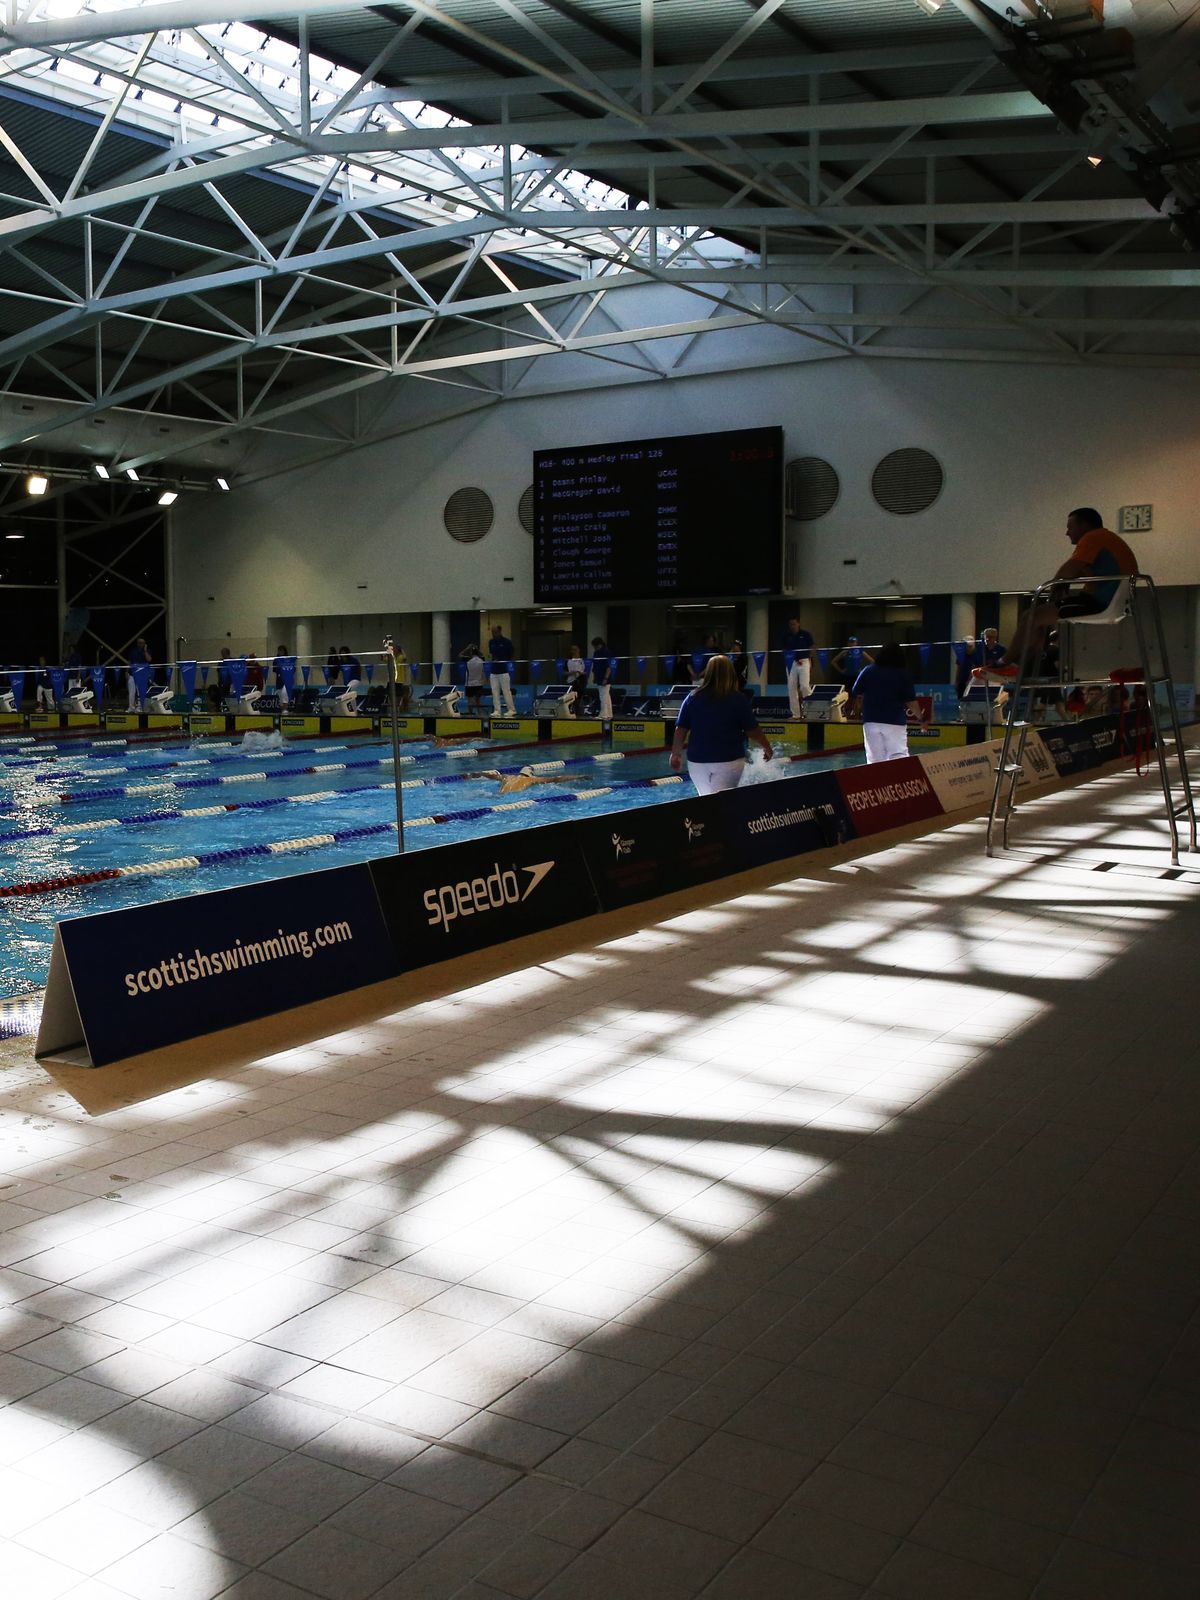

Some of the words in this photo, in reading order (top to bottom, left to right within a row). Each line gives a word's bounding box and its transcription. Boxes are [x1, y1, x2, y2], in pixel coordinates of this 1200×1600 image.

[846, 789, 875, 812] PEOPLE
[875, 784, 899, 807] MAKE
[897, 776, 930, 803] GLASGOW
[424, 862, 520, 933] speedo
[125, 919, 353, 997] scottishswimming.com
